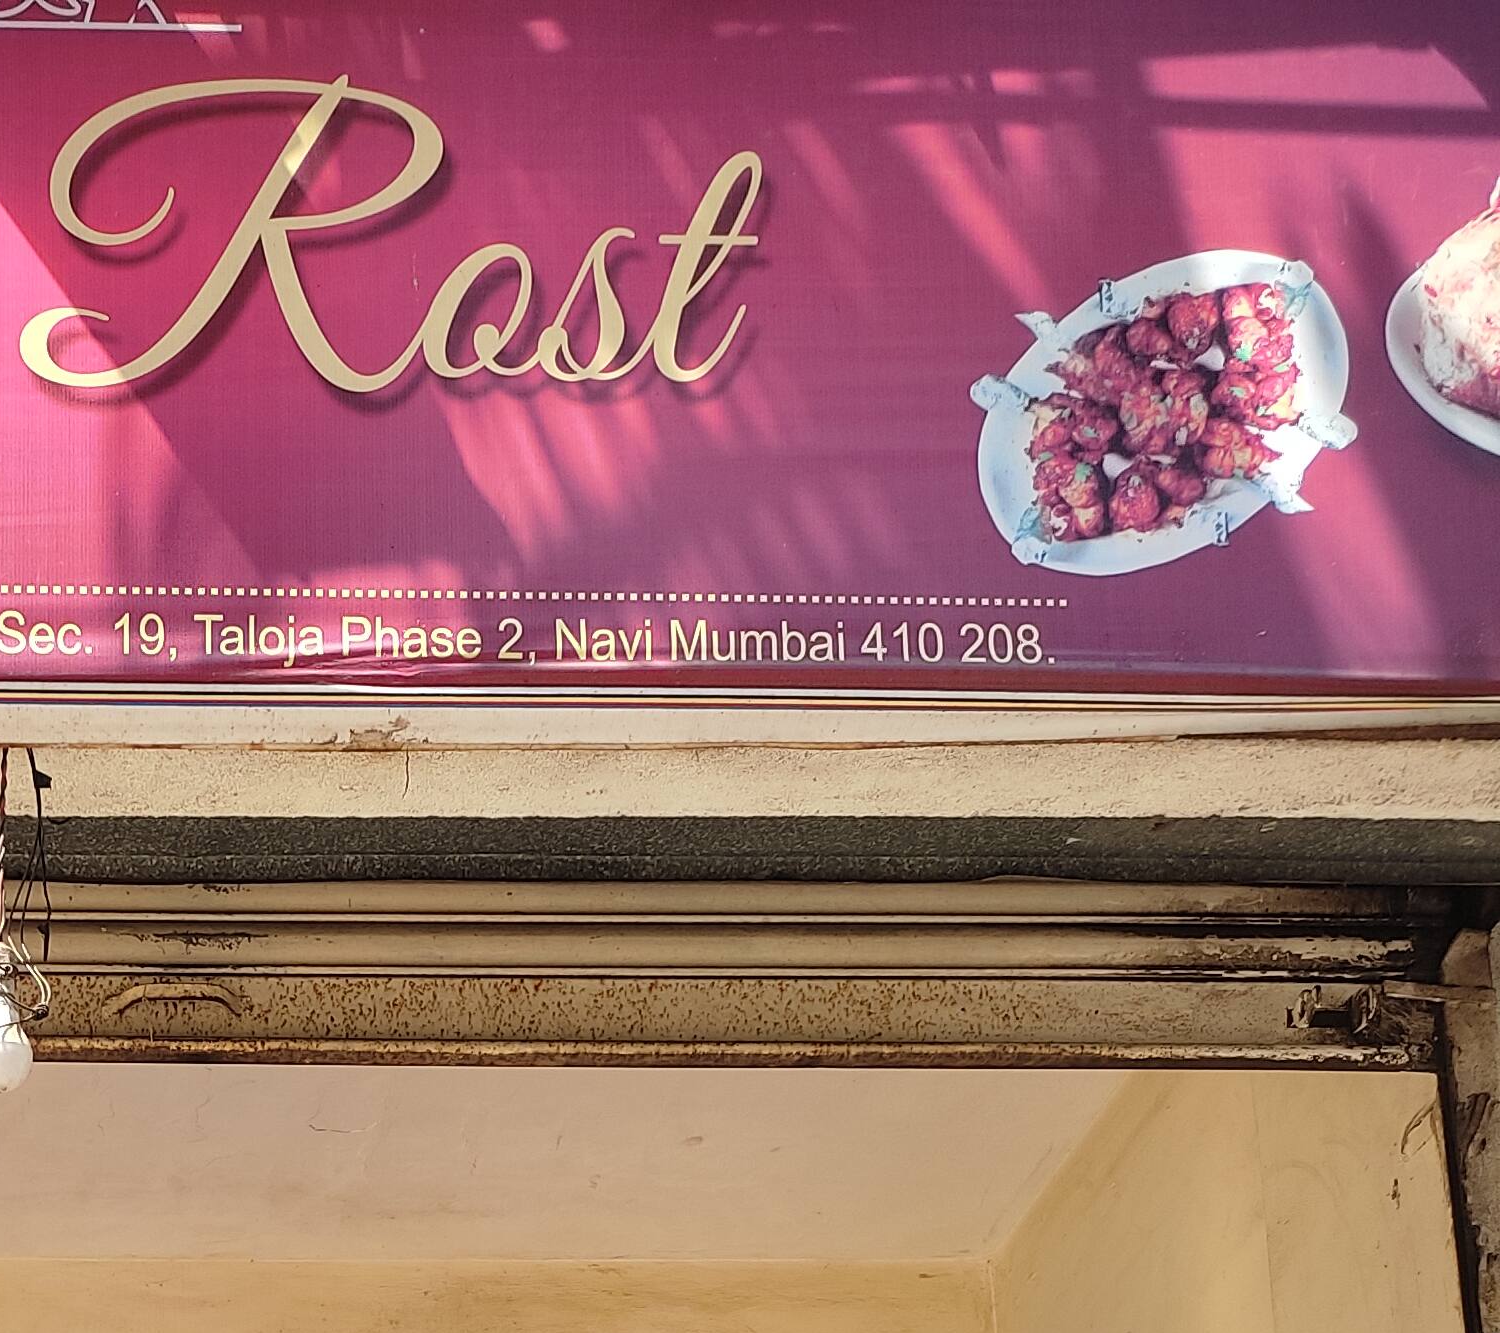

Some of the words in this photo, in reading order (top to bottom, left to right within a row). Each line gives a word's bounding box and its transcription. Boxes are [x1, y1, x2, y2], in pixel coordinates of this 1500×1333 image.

[19, 73, 762, 392] Rost
[114, 613, 177, 661] 19,
[194, 614, 324, 667] Taloja
[341, 615, 481, 659] Phase
[497, 618, 536, 664] 2,
[554, 618, 653, 662] Navi
[669, 619, 845, 664] Mumbai
[860, 621, 943, 664] 410
[959, 623, 1056, 665] 208.
